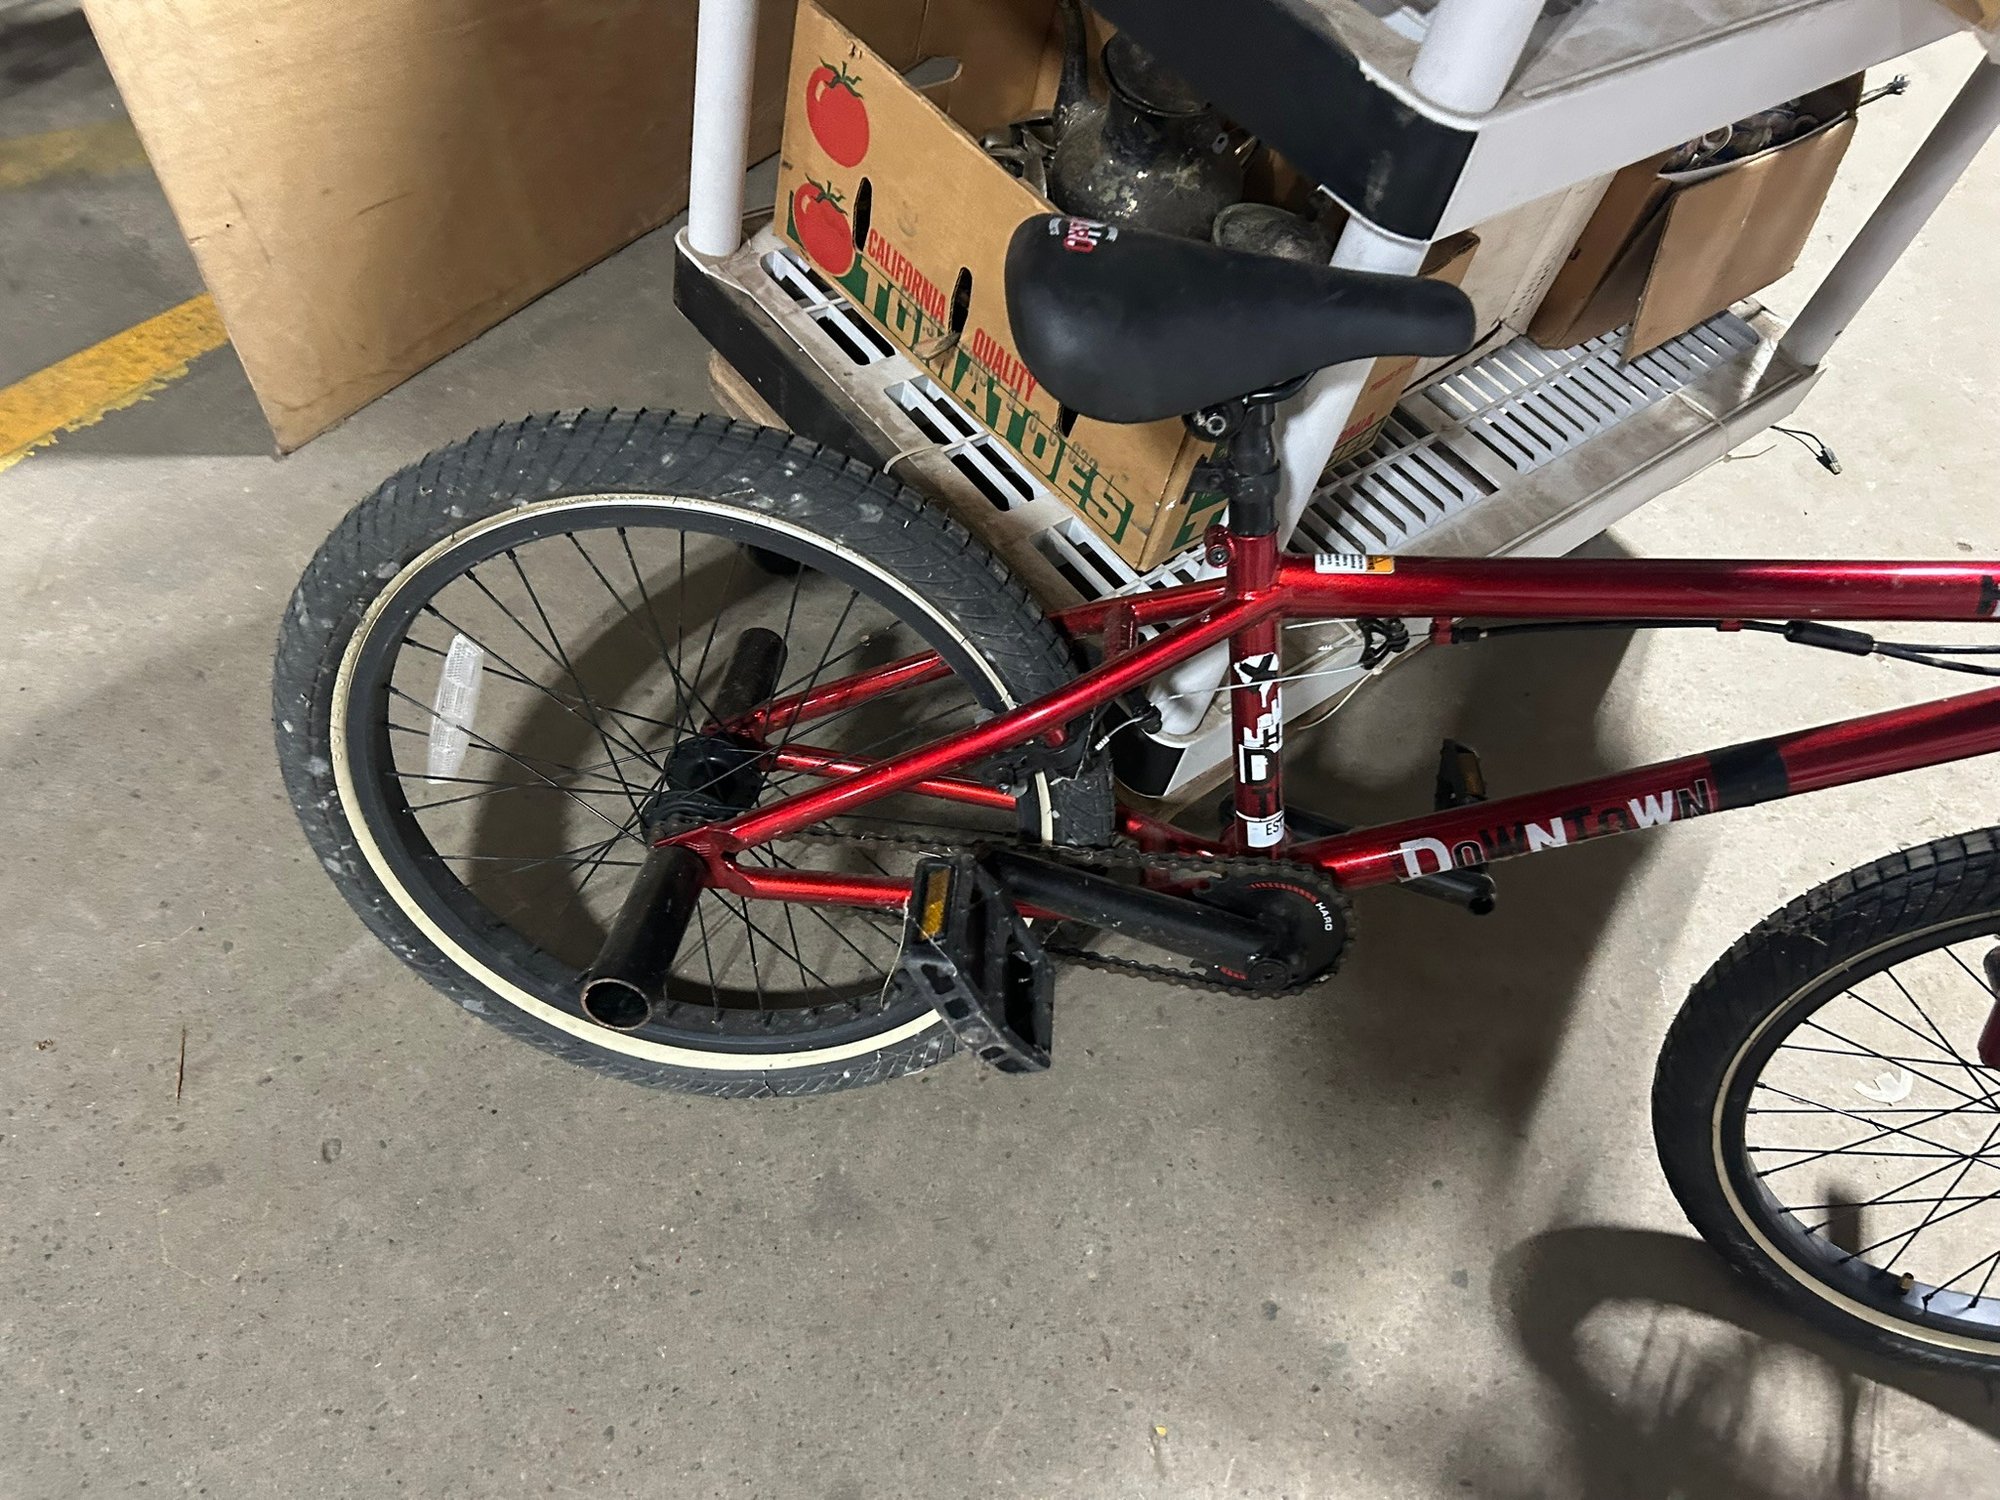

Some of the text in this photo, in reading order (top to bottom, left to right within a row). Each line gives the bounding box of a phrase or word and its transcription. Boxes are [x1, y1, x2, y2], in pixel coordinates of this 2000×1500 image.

[860, 254, 1128, 537] TOMATOES
[867, 228, 946, 326] CALIFORNIA
[972, 327, 1039, 403] QUALITY
[1315, 901, 1333, 932] HARO
